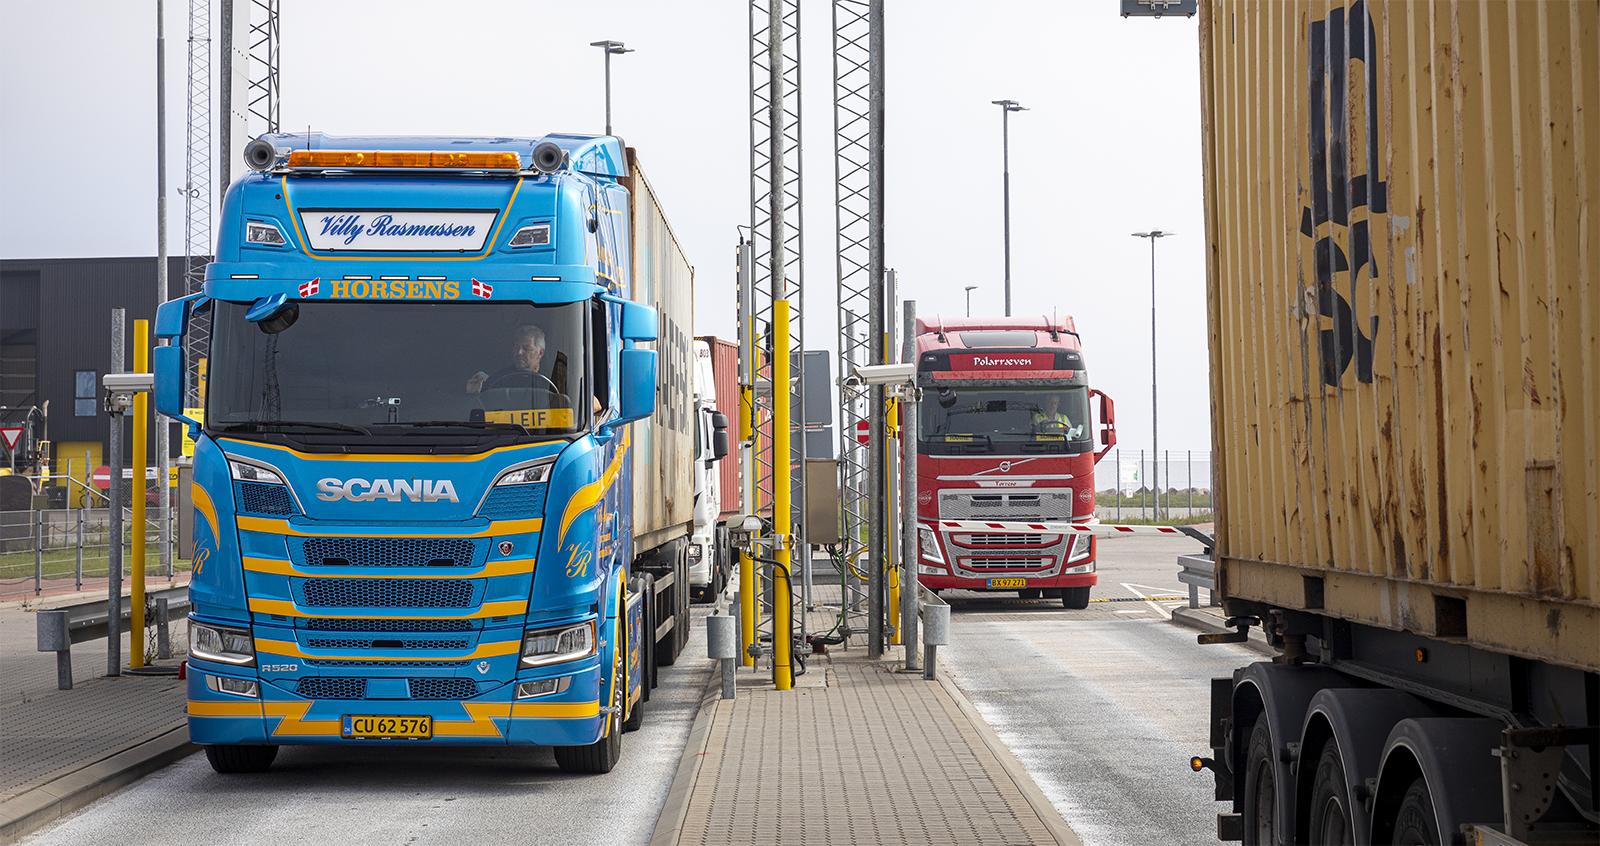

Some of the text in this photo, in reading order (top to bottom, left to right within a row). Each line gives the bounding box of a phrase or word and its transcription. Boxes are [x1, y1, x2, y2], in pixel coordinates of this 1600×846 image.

[319, 214, 476, 246] Villy Rasmussen
[330, 280, 461, 300] HORSENS
[973, 356, 1032, 366] Polarræven
[315, 477, 460, 503] SCANIA
[261, 663, 298, 672] R 520
[353, 718, 428, 734] CU 62 576
